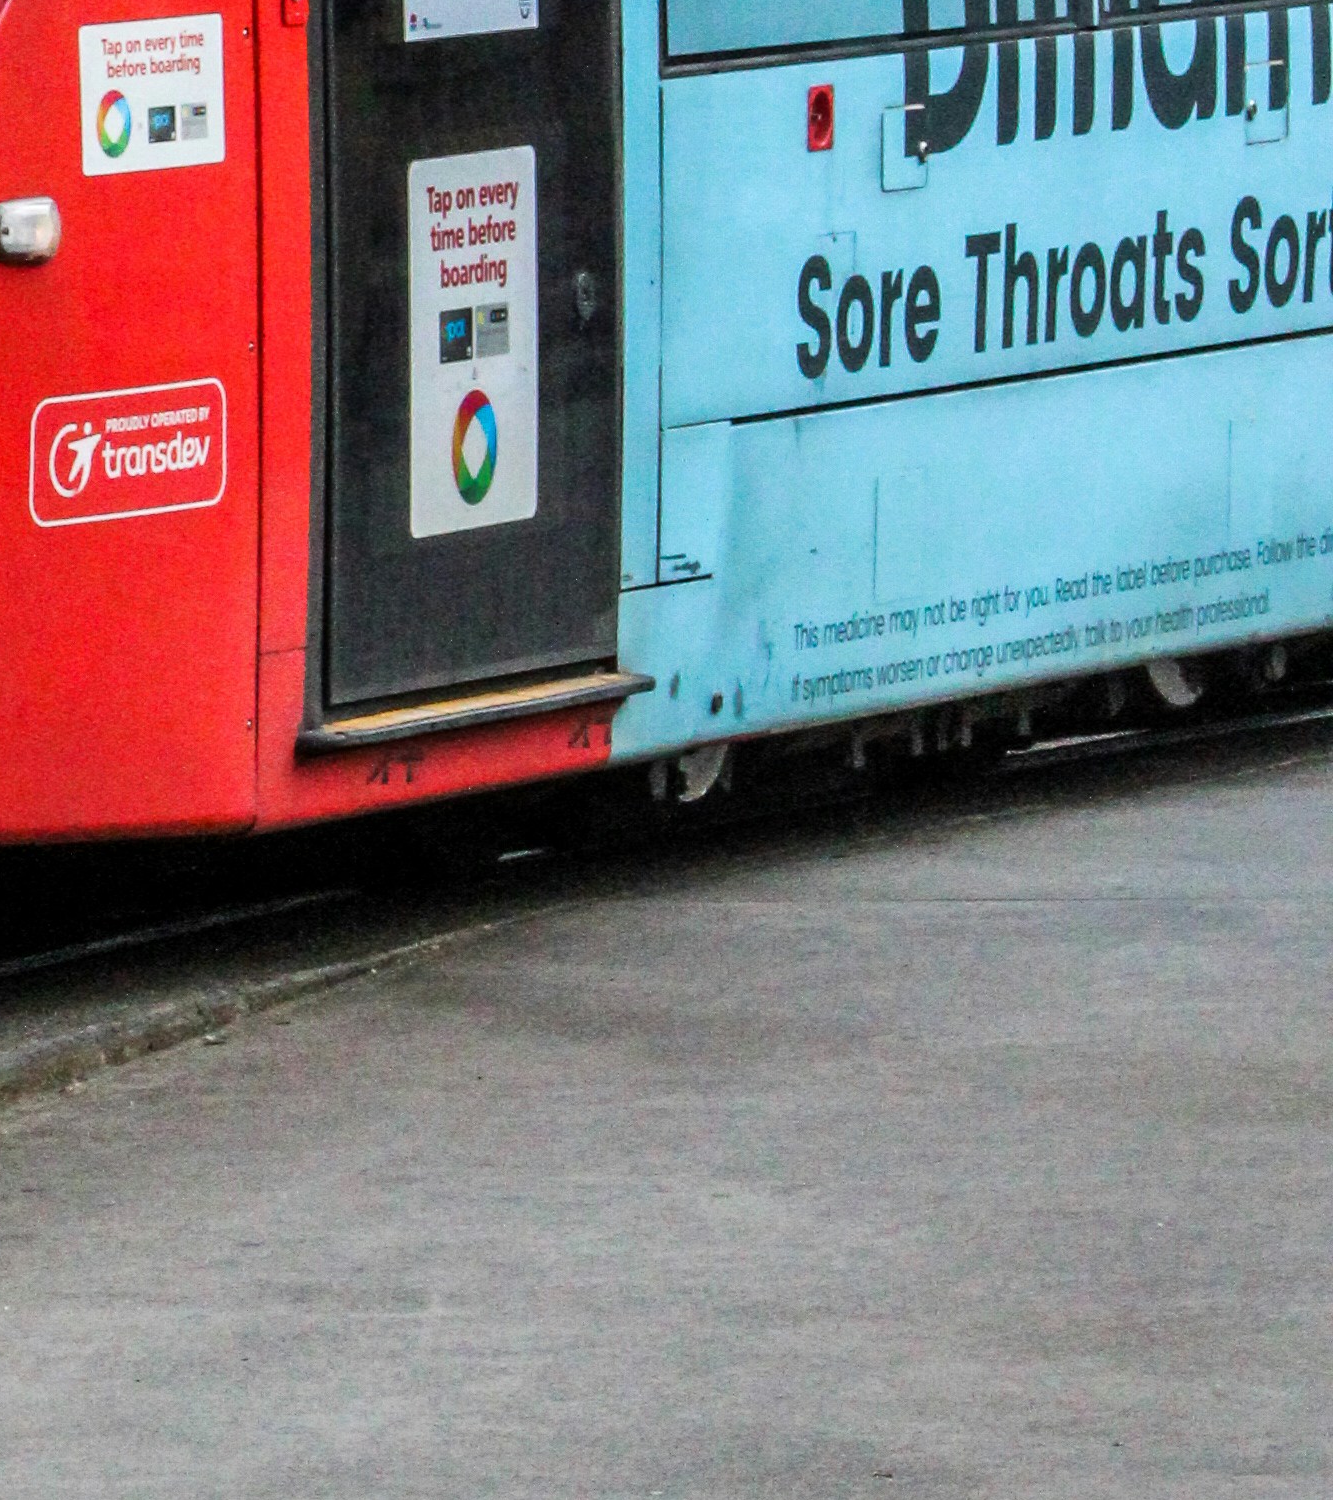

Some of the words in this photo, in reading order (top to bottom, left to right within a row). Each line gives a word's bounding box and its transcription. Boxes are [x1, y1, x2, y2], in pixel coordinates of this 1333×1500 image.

[101, 38, 122, 58] Tap
[125, 38, 141, 53] on
[144, 35, 176, 54] every
[178, 30, 205, 48] time
[106, 59, 147, 79] before
[149, 53, 201, 75] boarding
[426, 185, 452, 219] Tap
[456, 187, 476, 210] on
[479, 180, 519, 210] every
[430, 222, 464, 252] time
[468, 214, 517, 247] before
[440, 253, 508, 289] boarding
[796, 254, 942, 380] Sore
[964, 209, 1206, 355] Throats
[1228, 195, 1333, 315] Sor
[105, 414, 151, 433] PROUDLY
[151, 407, 198, 428] OPERATED
[198, 406, 210, 422] BY
[102, 430, 211, 479] transdev
[794, 621, 818, 650] This
[824, 609, 885, 643] medicine
[889, 607, 920, 638] may
[924, 601, 945, 625] not
[950, 596, 966, 622] be
[971, 591, 1000, 627] right
[1004, 585, 1020, 612] for
[1055, 572, 1087, 602] Read
[1092, 570, 1111, 595] the
[1117, 561, 1147, 592] label
[1150, 556, 1190, 586] before
[1257, 538, 1293, 566] Follow
[1297, 533, 1315, 559] the
[791, 672, 799, 701] If
[803, 666, 874, 706] symptoms
[876, 658, 923, 686] worsen
[926, 654, 941, 677] or
[944, 645, 993, 677] change
[1085, 620, 1105, 647] talk
[1110, 619, 1123, 642] to
[1126, 614, 1153, 646] your
[1155, 602, 1194, 634] health
